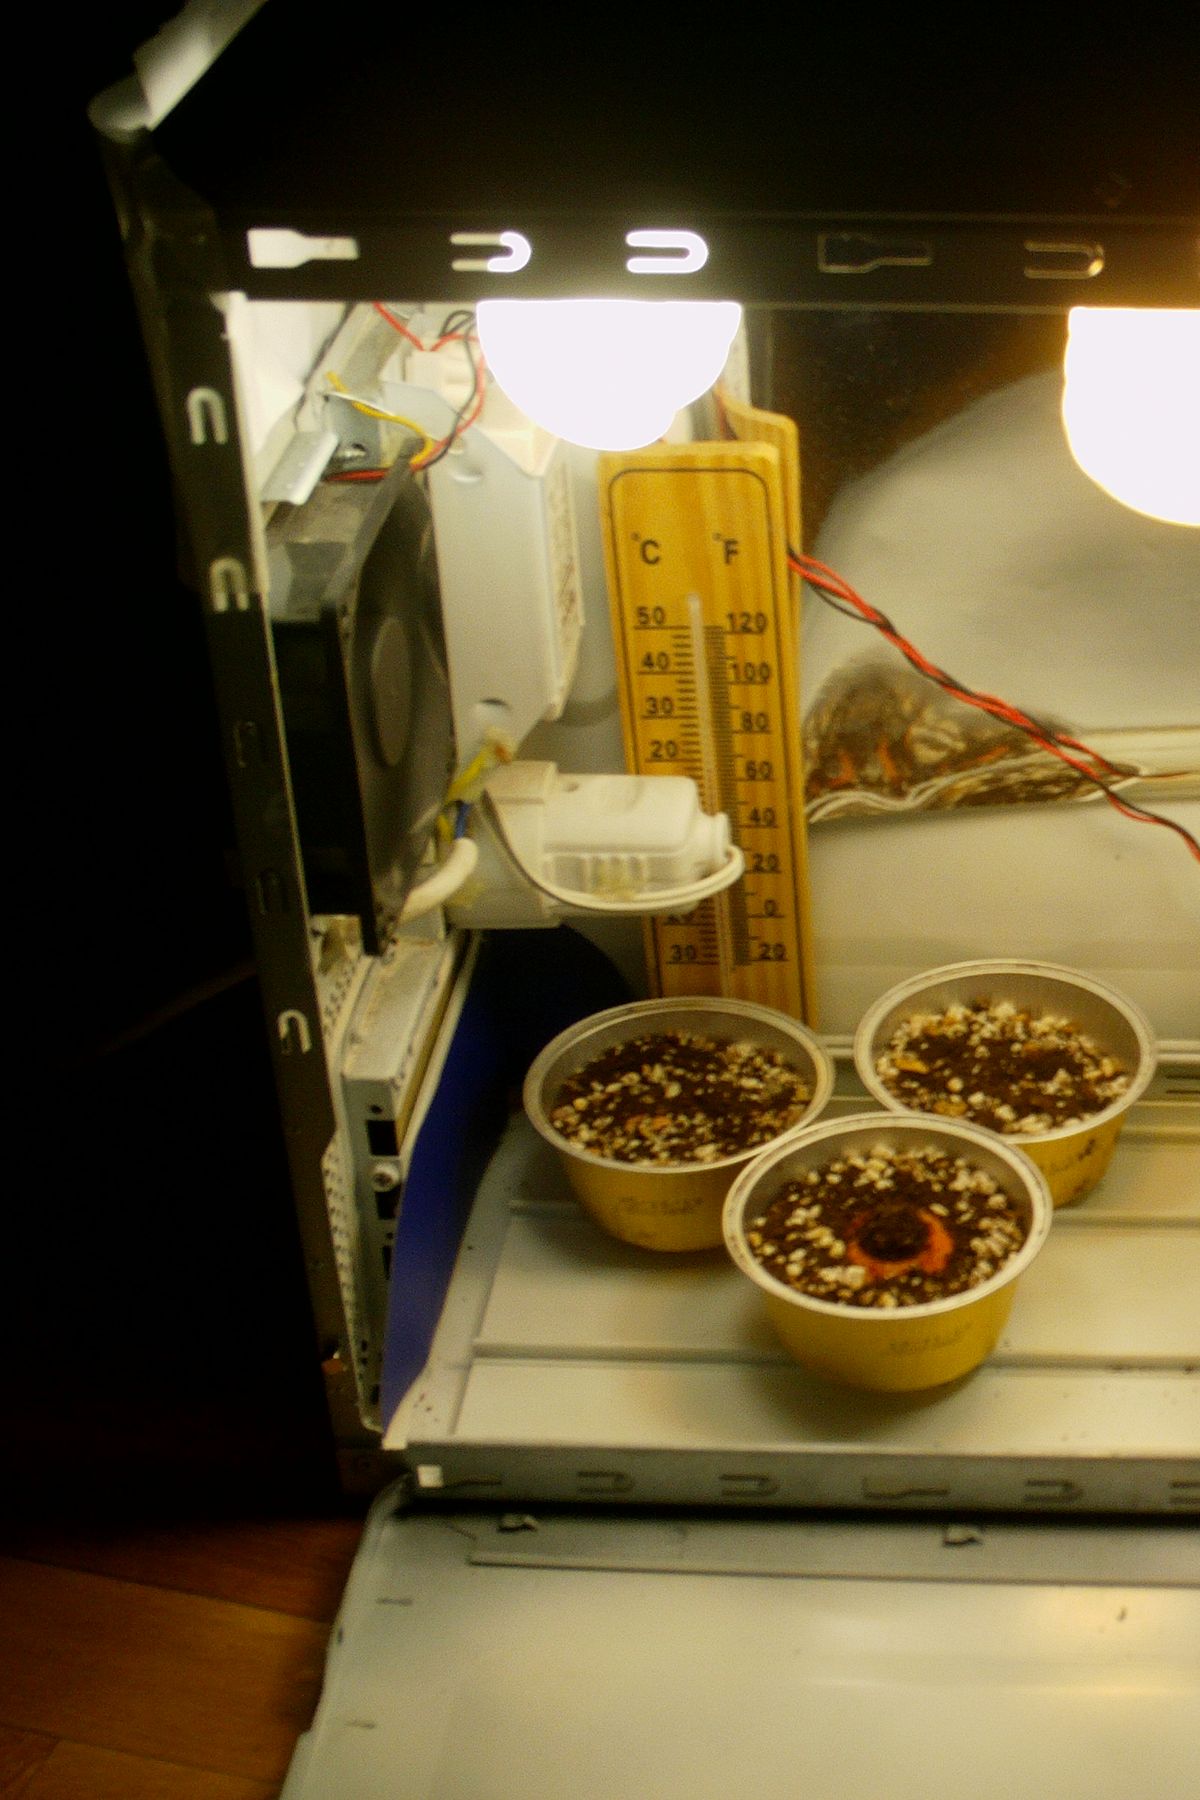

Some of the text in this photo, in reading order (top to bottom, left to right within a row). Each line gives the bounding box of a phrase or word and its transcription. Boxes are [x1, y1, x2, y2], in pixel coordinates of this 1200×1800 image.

[637, 606, 665, 625] 50
[727, 612, 768, 632] 120
[643, 652, 670, 670] 40
[732, 662, 770, 683] 100
[646, 696, 674, 714] 30
[741, 712, 769, 730] 80
[651, 740, 678, 758] 20
[750, 807, 776, 826] 40
[753, 854, 780, 872] 20
[764, 899, 778, 916] 0
[671, 944, 697, 961] 30
[759, 943, 787, 960] 20
